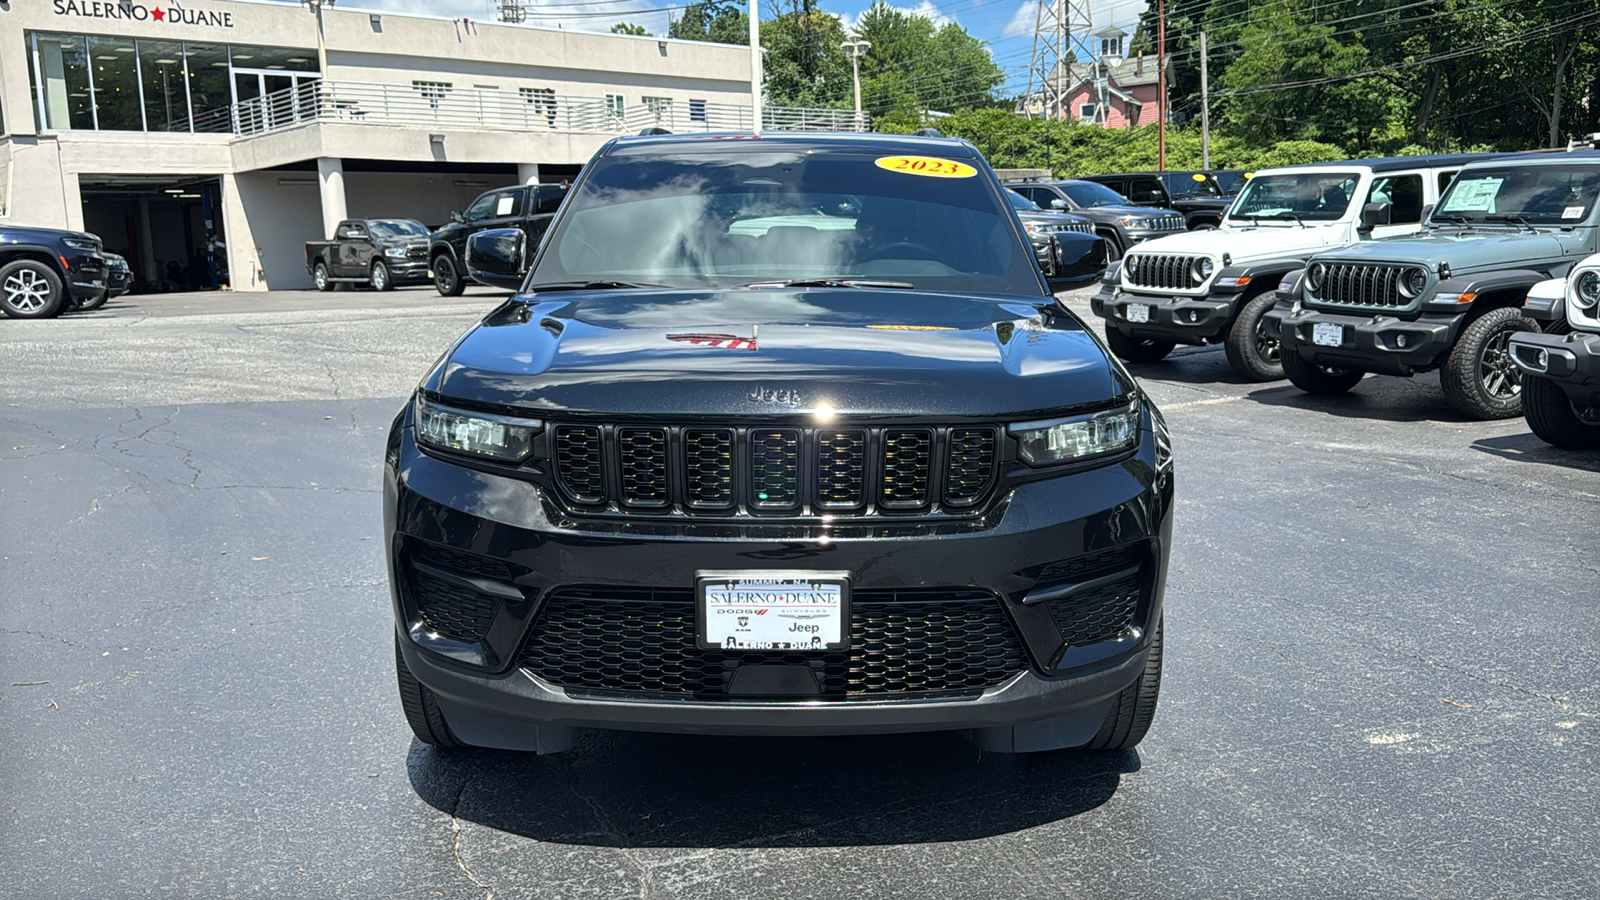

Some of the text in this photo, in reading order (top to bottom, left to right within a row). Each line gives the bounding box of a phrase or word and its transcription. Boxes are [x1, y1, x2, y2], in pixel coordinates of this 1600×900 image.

[53, 0, 234, 28] SALERNO DUANE
[894, 159, 959, 174] 2023
[745, 384, 801, 408] Jeep
[710, 592, 837, 604] SALERNO DUANE
[788, 622, 820, 634] Jeep
[720, 641, 828, 650] SALERNO DUANE
